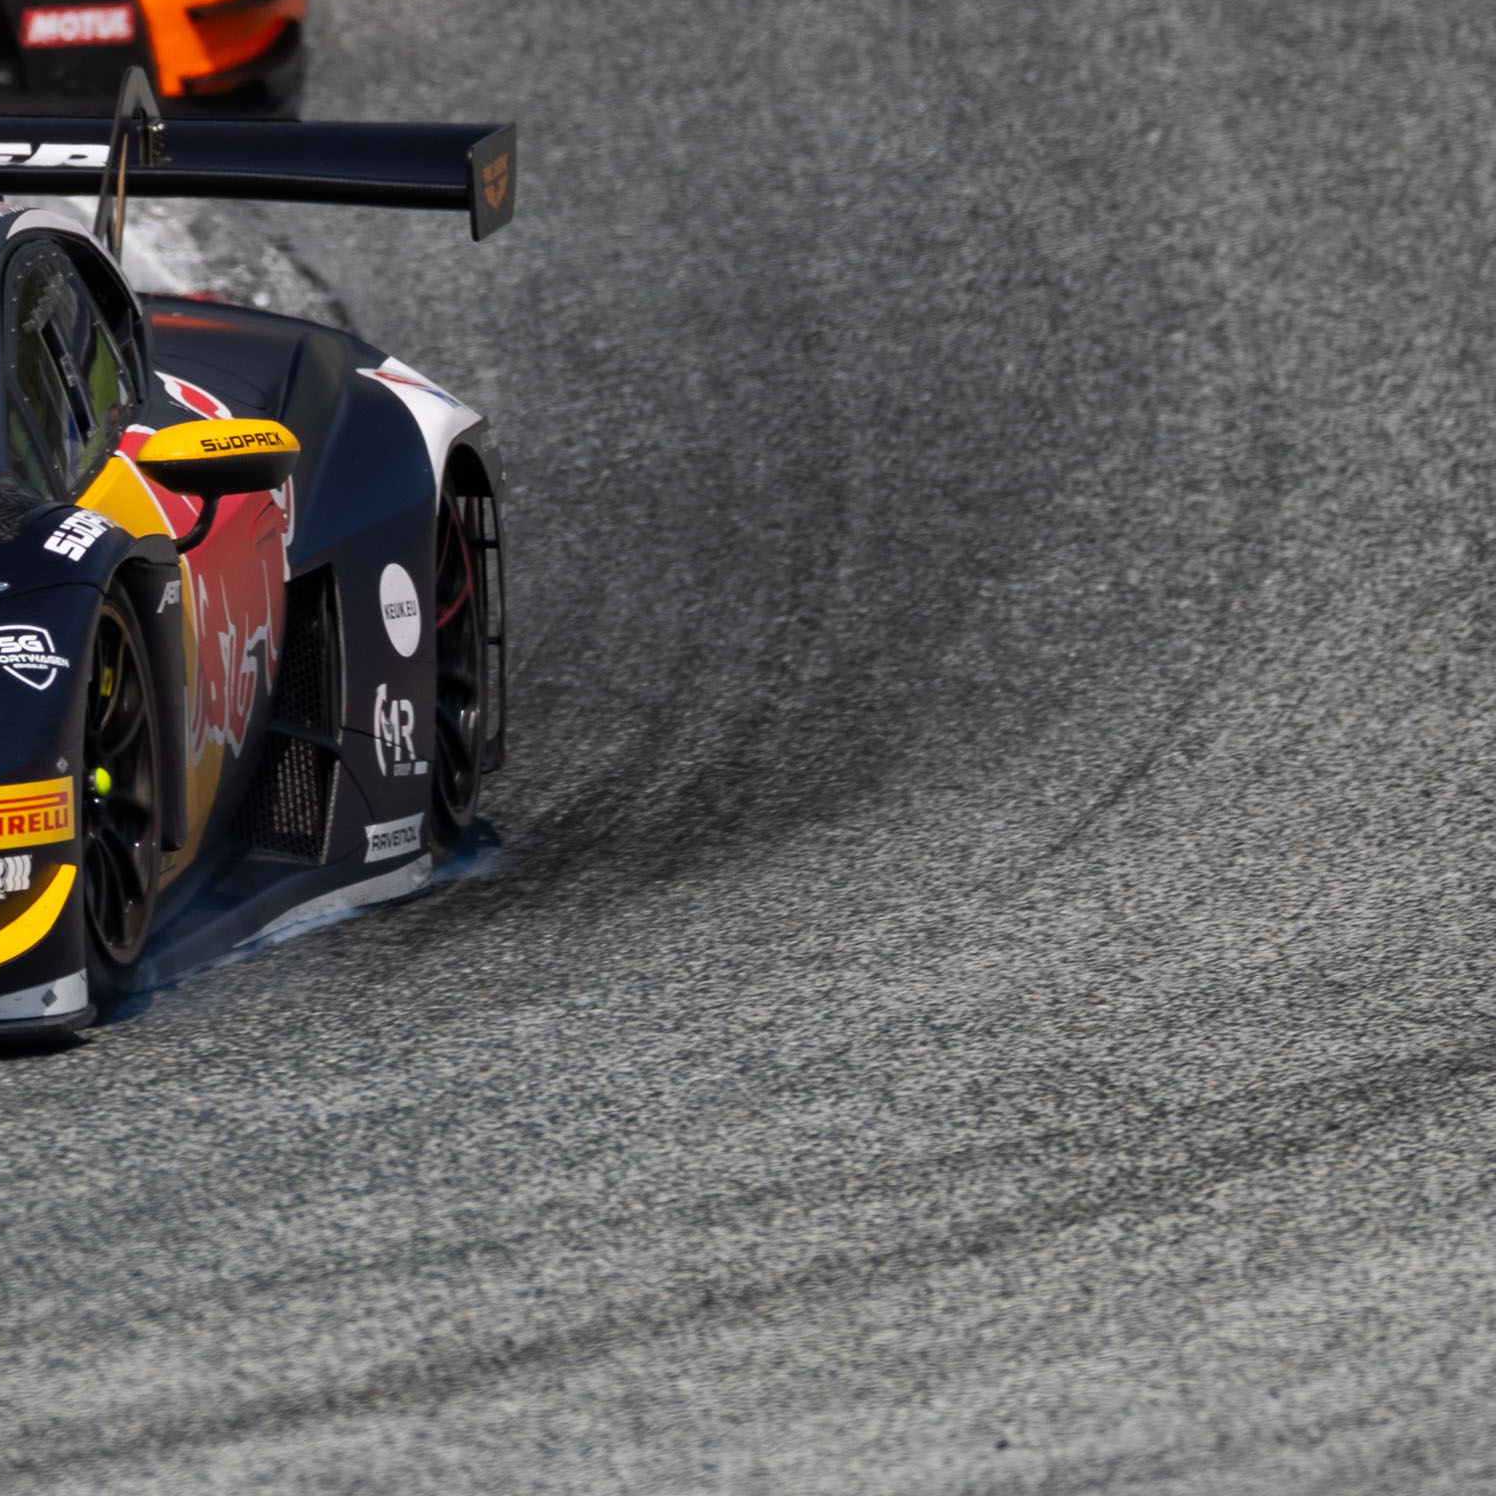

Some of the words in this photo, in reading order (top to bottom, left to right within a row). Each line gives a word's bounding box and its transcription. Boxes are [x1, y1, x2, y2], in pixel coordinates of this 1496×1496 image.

[26, 6, 132, 43] MOTUL
[200, 432, 285, 452] SÜDPACK
[157, 579, 181, 614] ABT
[371, 825, 418, 852] RAVENOL
